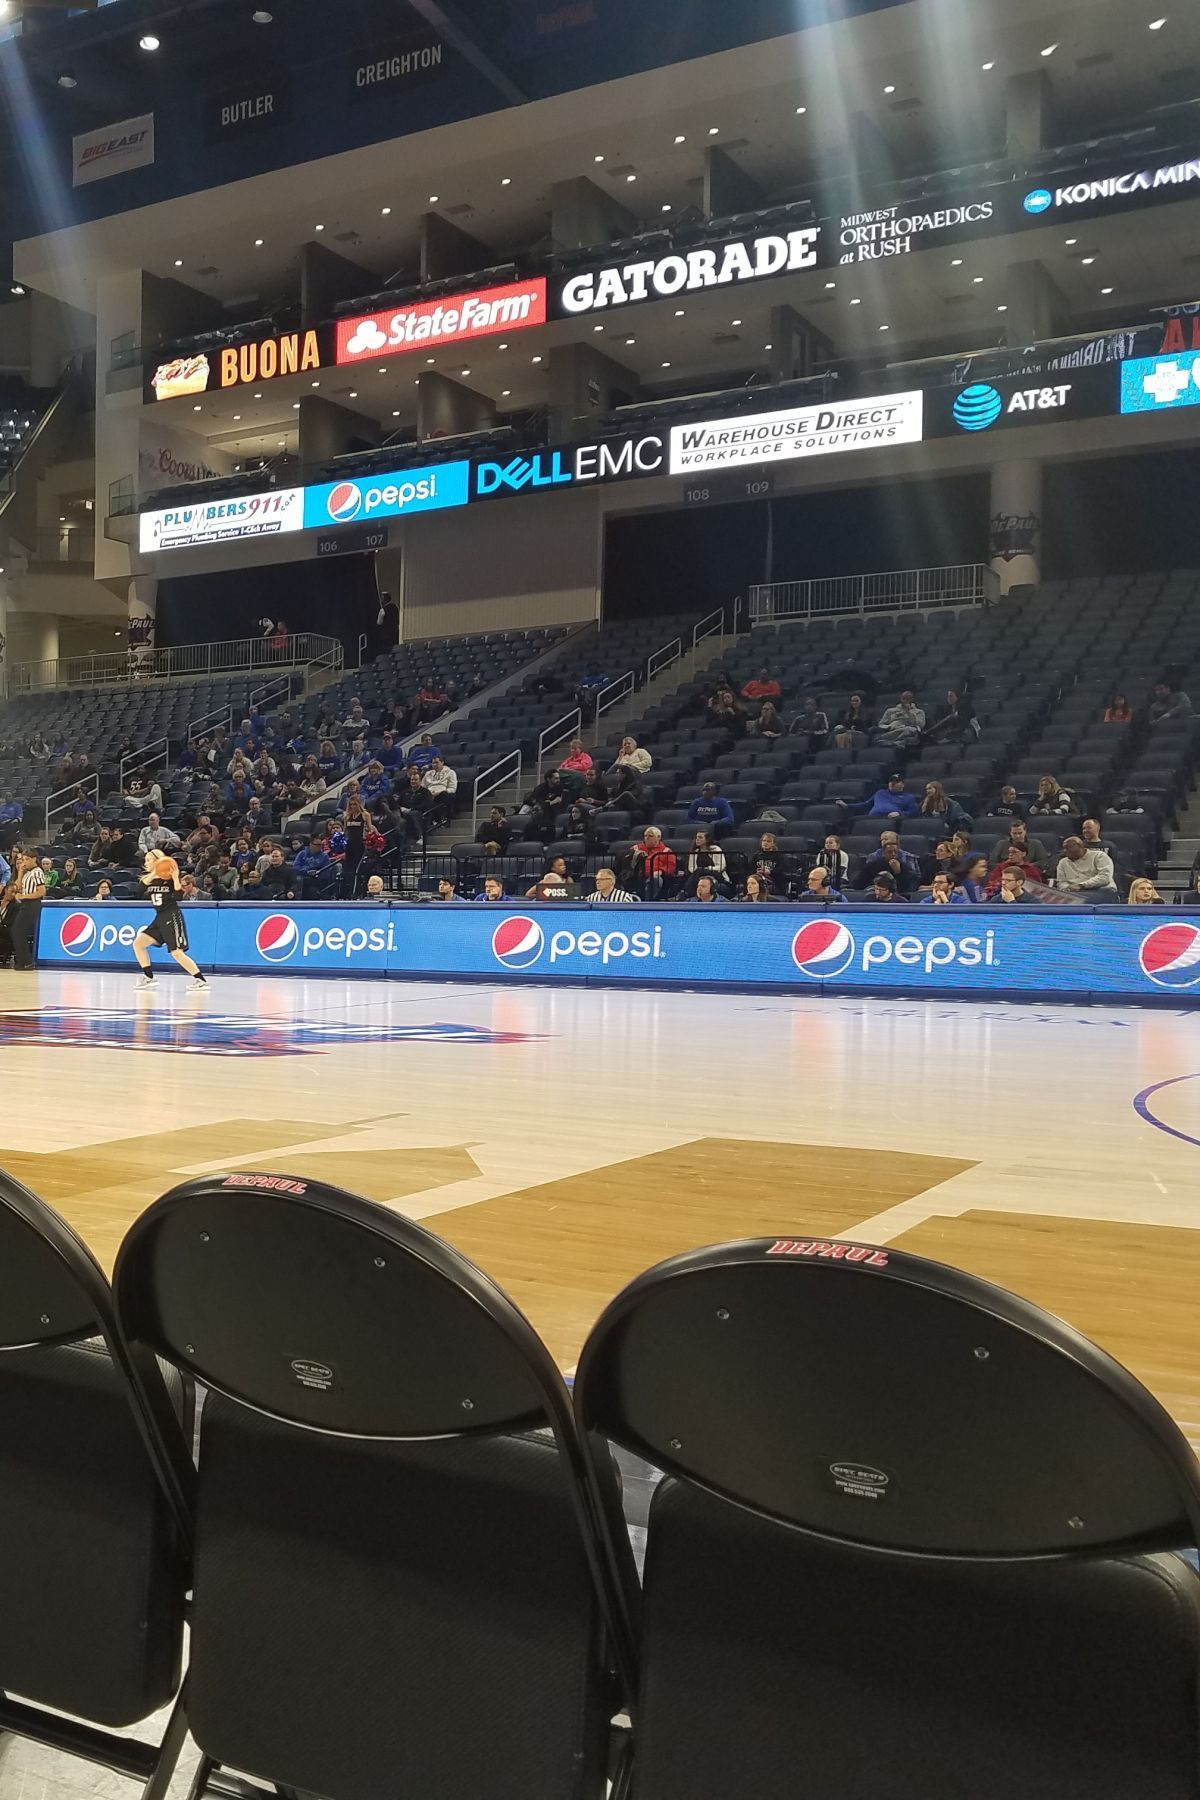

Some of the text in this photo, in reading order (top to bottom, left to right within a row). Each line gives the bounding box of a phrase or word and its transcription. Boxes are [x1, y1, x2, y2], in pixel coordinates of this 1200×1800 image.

[356, 44, 442, 87] CREIGHTON
[221, 94, 274, 126] BUTLER
[1056, 171, 1150, 207] KONICA
[840, 206, 899, 228] MIDWEST
[840, 201, 994, 246] ORTHOPAEDICS
[840, 235, 911, 265] at RUSH
[562, 227, 820, 314] GATORADE
[221, 329, 320, 387] BUONA
[1006, 384, 1072, 413] AT&T
[680, 426, 897, 465] WORKPLACE SOLUTIONS
[477, 434, 663, 495] DELL EMC
[365, 474, 438, 513] pepsi
[687, 481, 769, 501] 108 109
[319, 534, 384, 552] 106 107
[150, 893, 163, 906] 15
[548, 888, 569, 897] POSS.
[302, 921, 394, 958] pepsi
[550, 925, 662, 964] pepsi
[862, 929, 994, 973] pepsi
[221, 1174, 308, 1195] DEPAUL
[765, 1240, 889, 1267] DEPAUL
